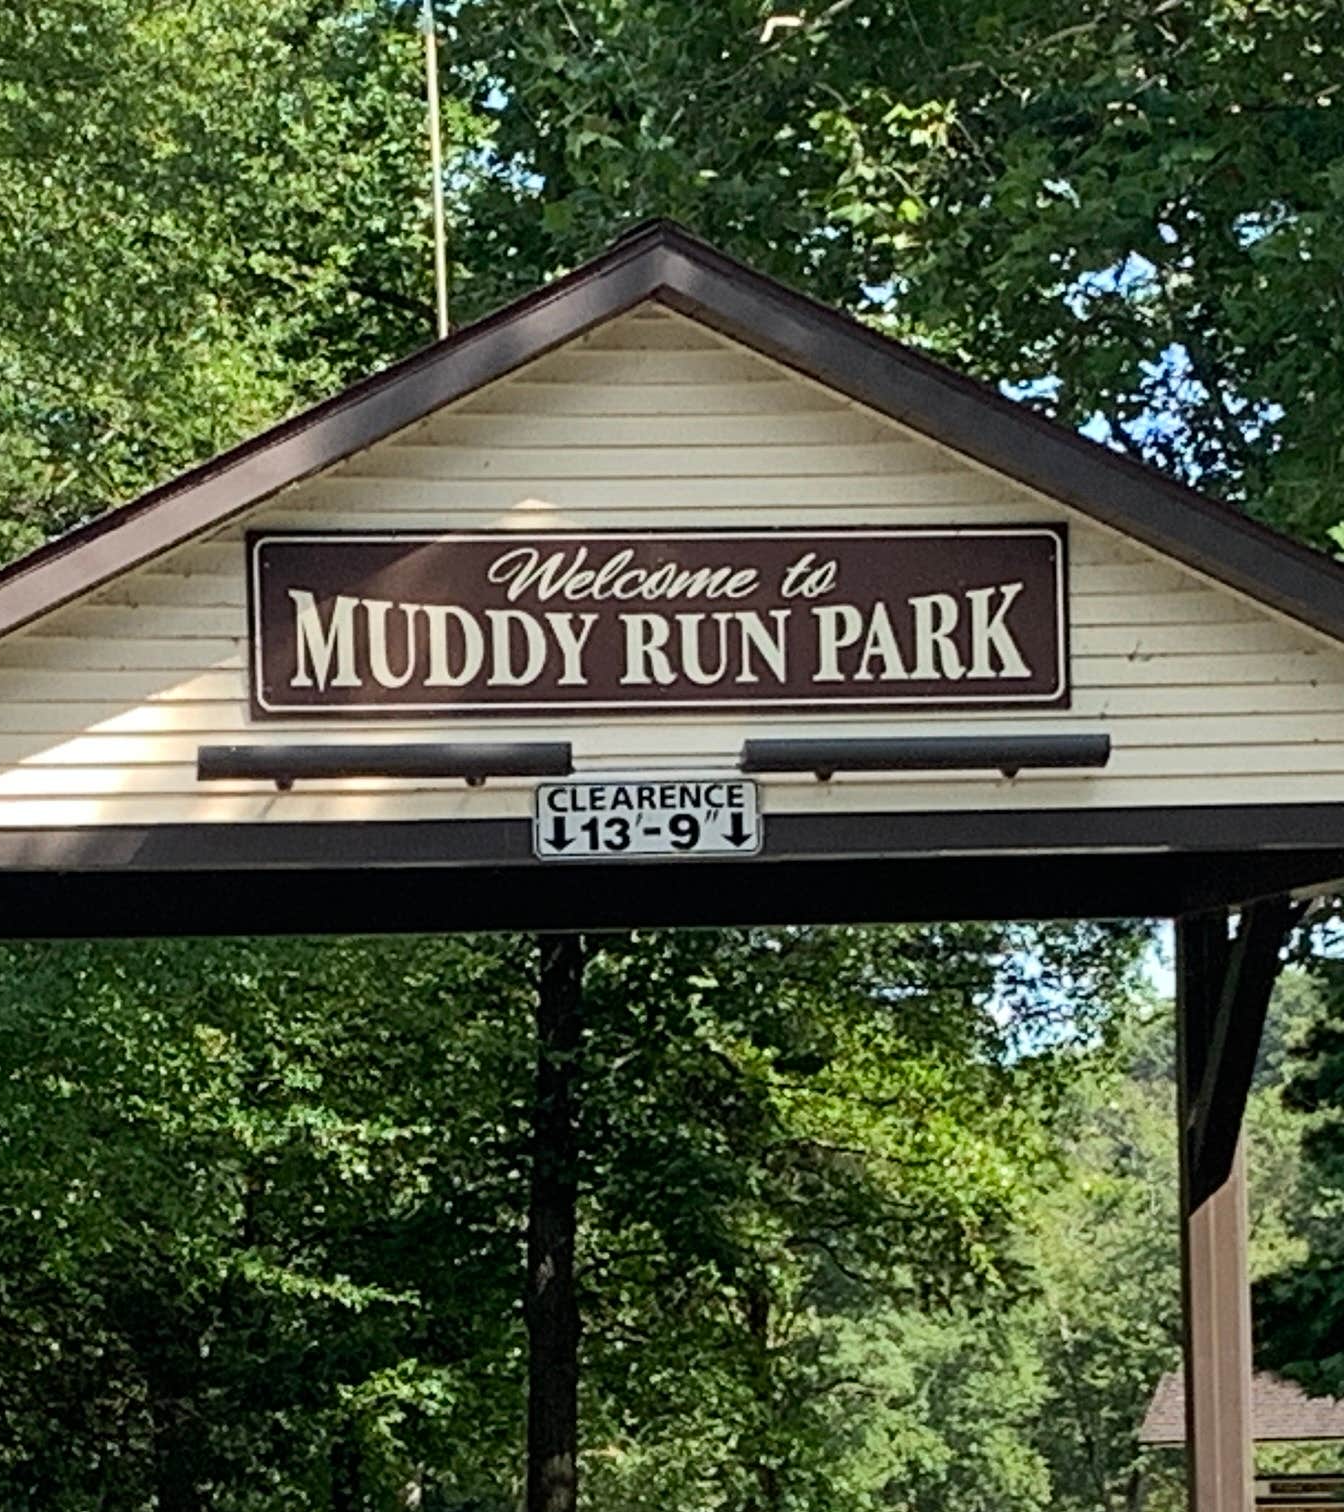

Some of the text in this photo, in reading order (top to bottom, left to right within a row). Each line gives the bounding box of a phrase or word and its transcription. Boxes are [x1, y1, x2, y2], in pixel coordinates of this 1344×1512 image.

[488, 547, 838, 601] Welcome to
[288, 580, 1032, 691] MUDDY RUN PARK
[547, 784, 744, 813] CLEARENCE
